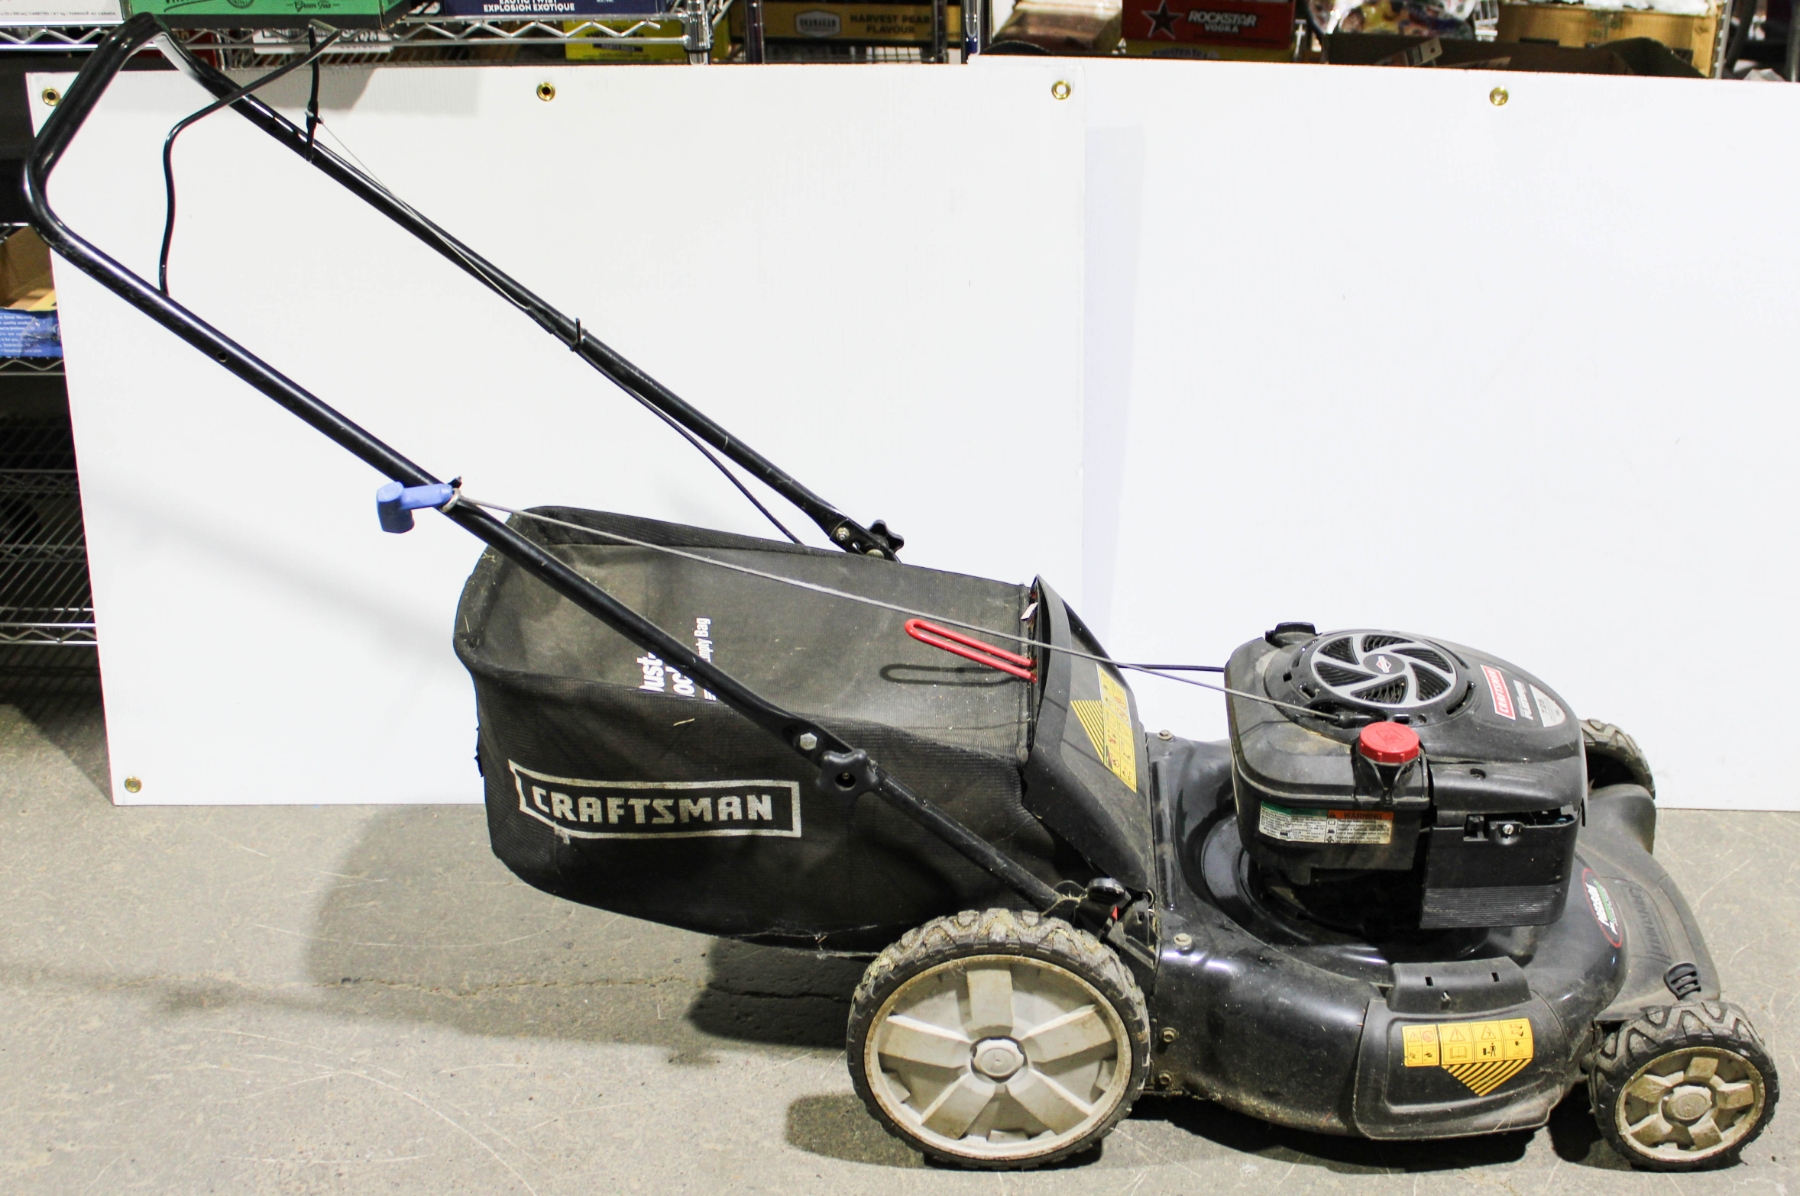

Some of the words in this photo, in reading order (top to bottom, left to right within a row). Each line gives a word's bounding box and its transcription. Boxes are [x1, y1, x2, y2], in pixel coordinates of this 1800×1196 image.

[294, 1, 317, 12] Green
[318, 1, 332, 9] Tea
[483, 4, 532, 13] EXPLOSION
[533, 3, 575, 13] EXOTIQUE
[850, 14, 898, 24] HARVEST
[902, 14, 931, 24] PEAR
[1188, 10, 1257, 27] ROCKSTAR
[866, 24, 915, 34] FLAVOUR
[1204, 23, 1239, 33] VODKA
[694, 617, 712, 637] Bag
[531, 785, 773, 825] CRAFTSMAN
[1344, 811, 1383, 820] WARNING
